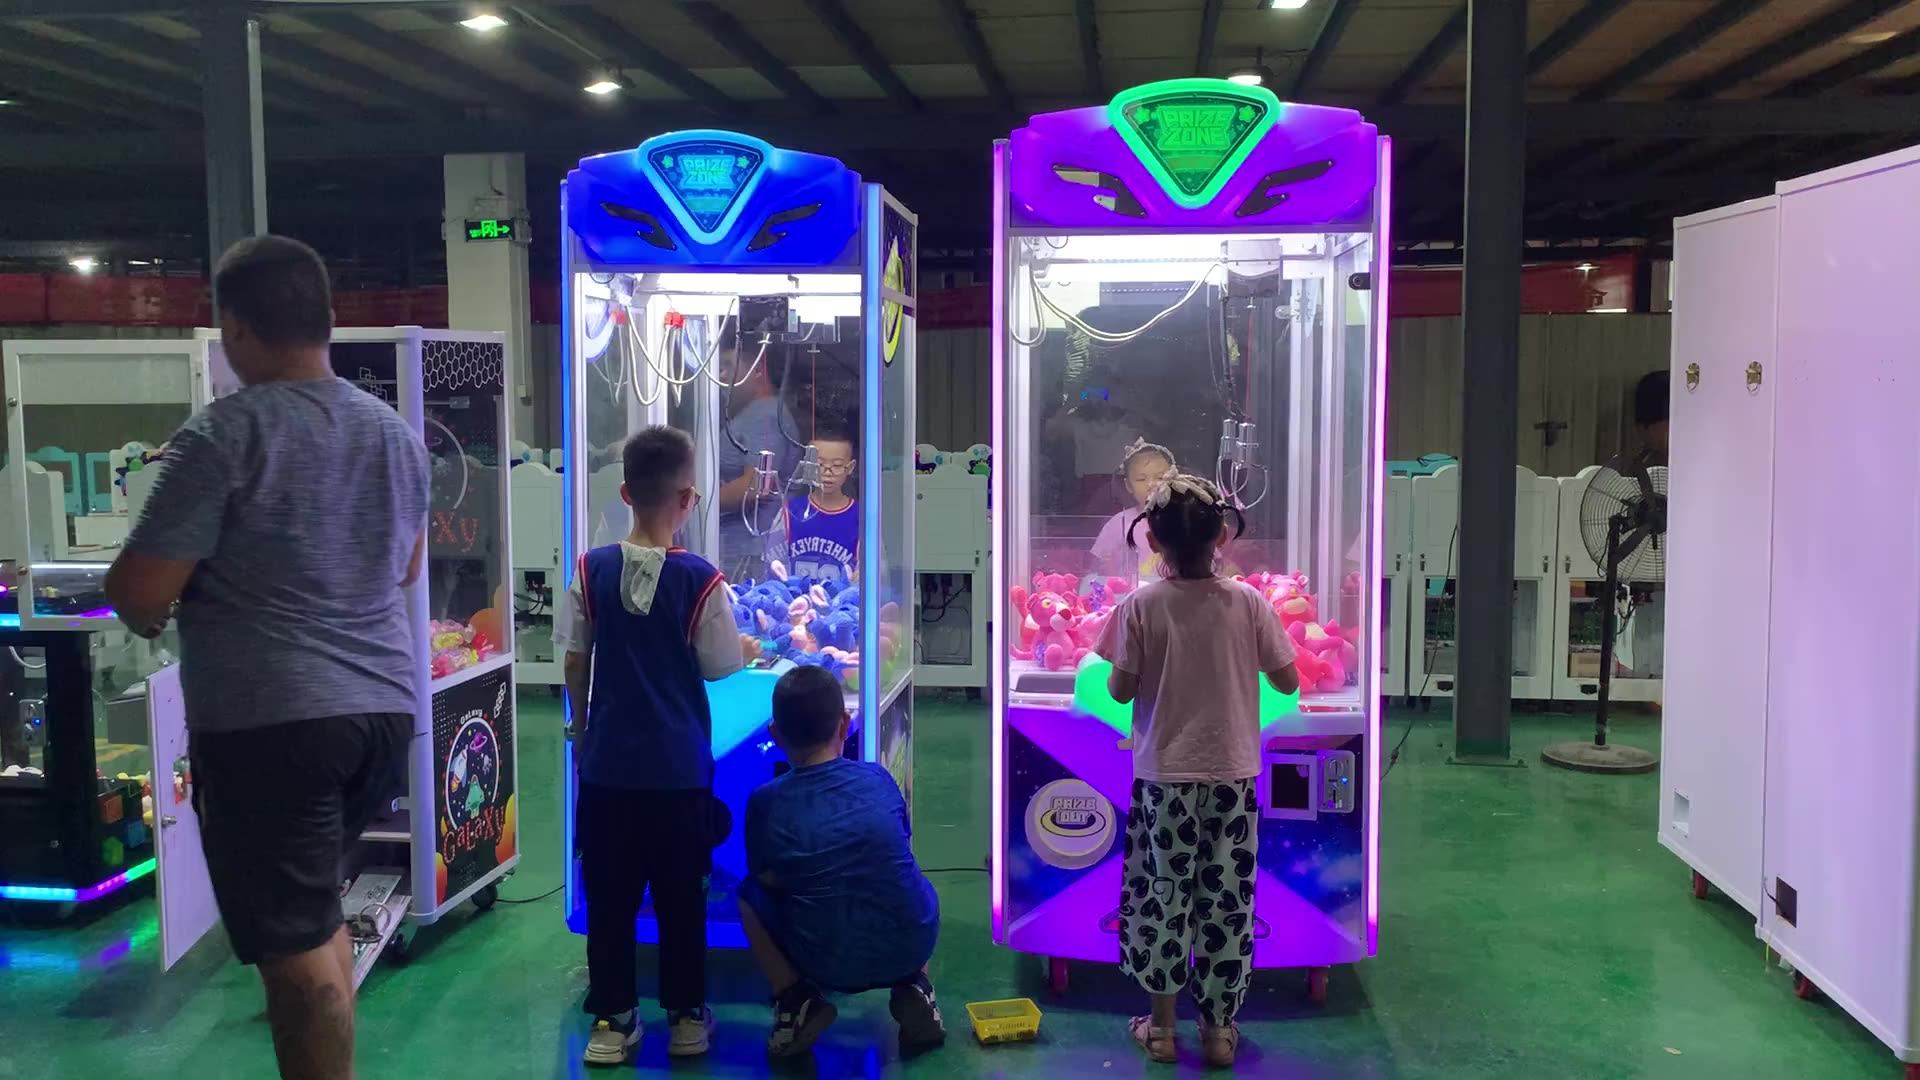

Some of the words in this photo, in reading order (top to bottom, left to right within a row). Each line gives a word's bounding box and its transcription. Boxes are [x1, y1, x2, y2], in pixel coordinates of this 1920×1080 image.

[1161, 108, 1233, 127] PRIZE
[1163, 127, 1231, 146] ZONE
[682, 158, 733, 172] PRIZE
[685, 172, 730, 187] ZONE
[1051, 798, 1096, 810] PRIZE
[1059, 810, 1089, 823] OUT
